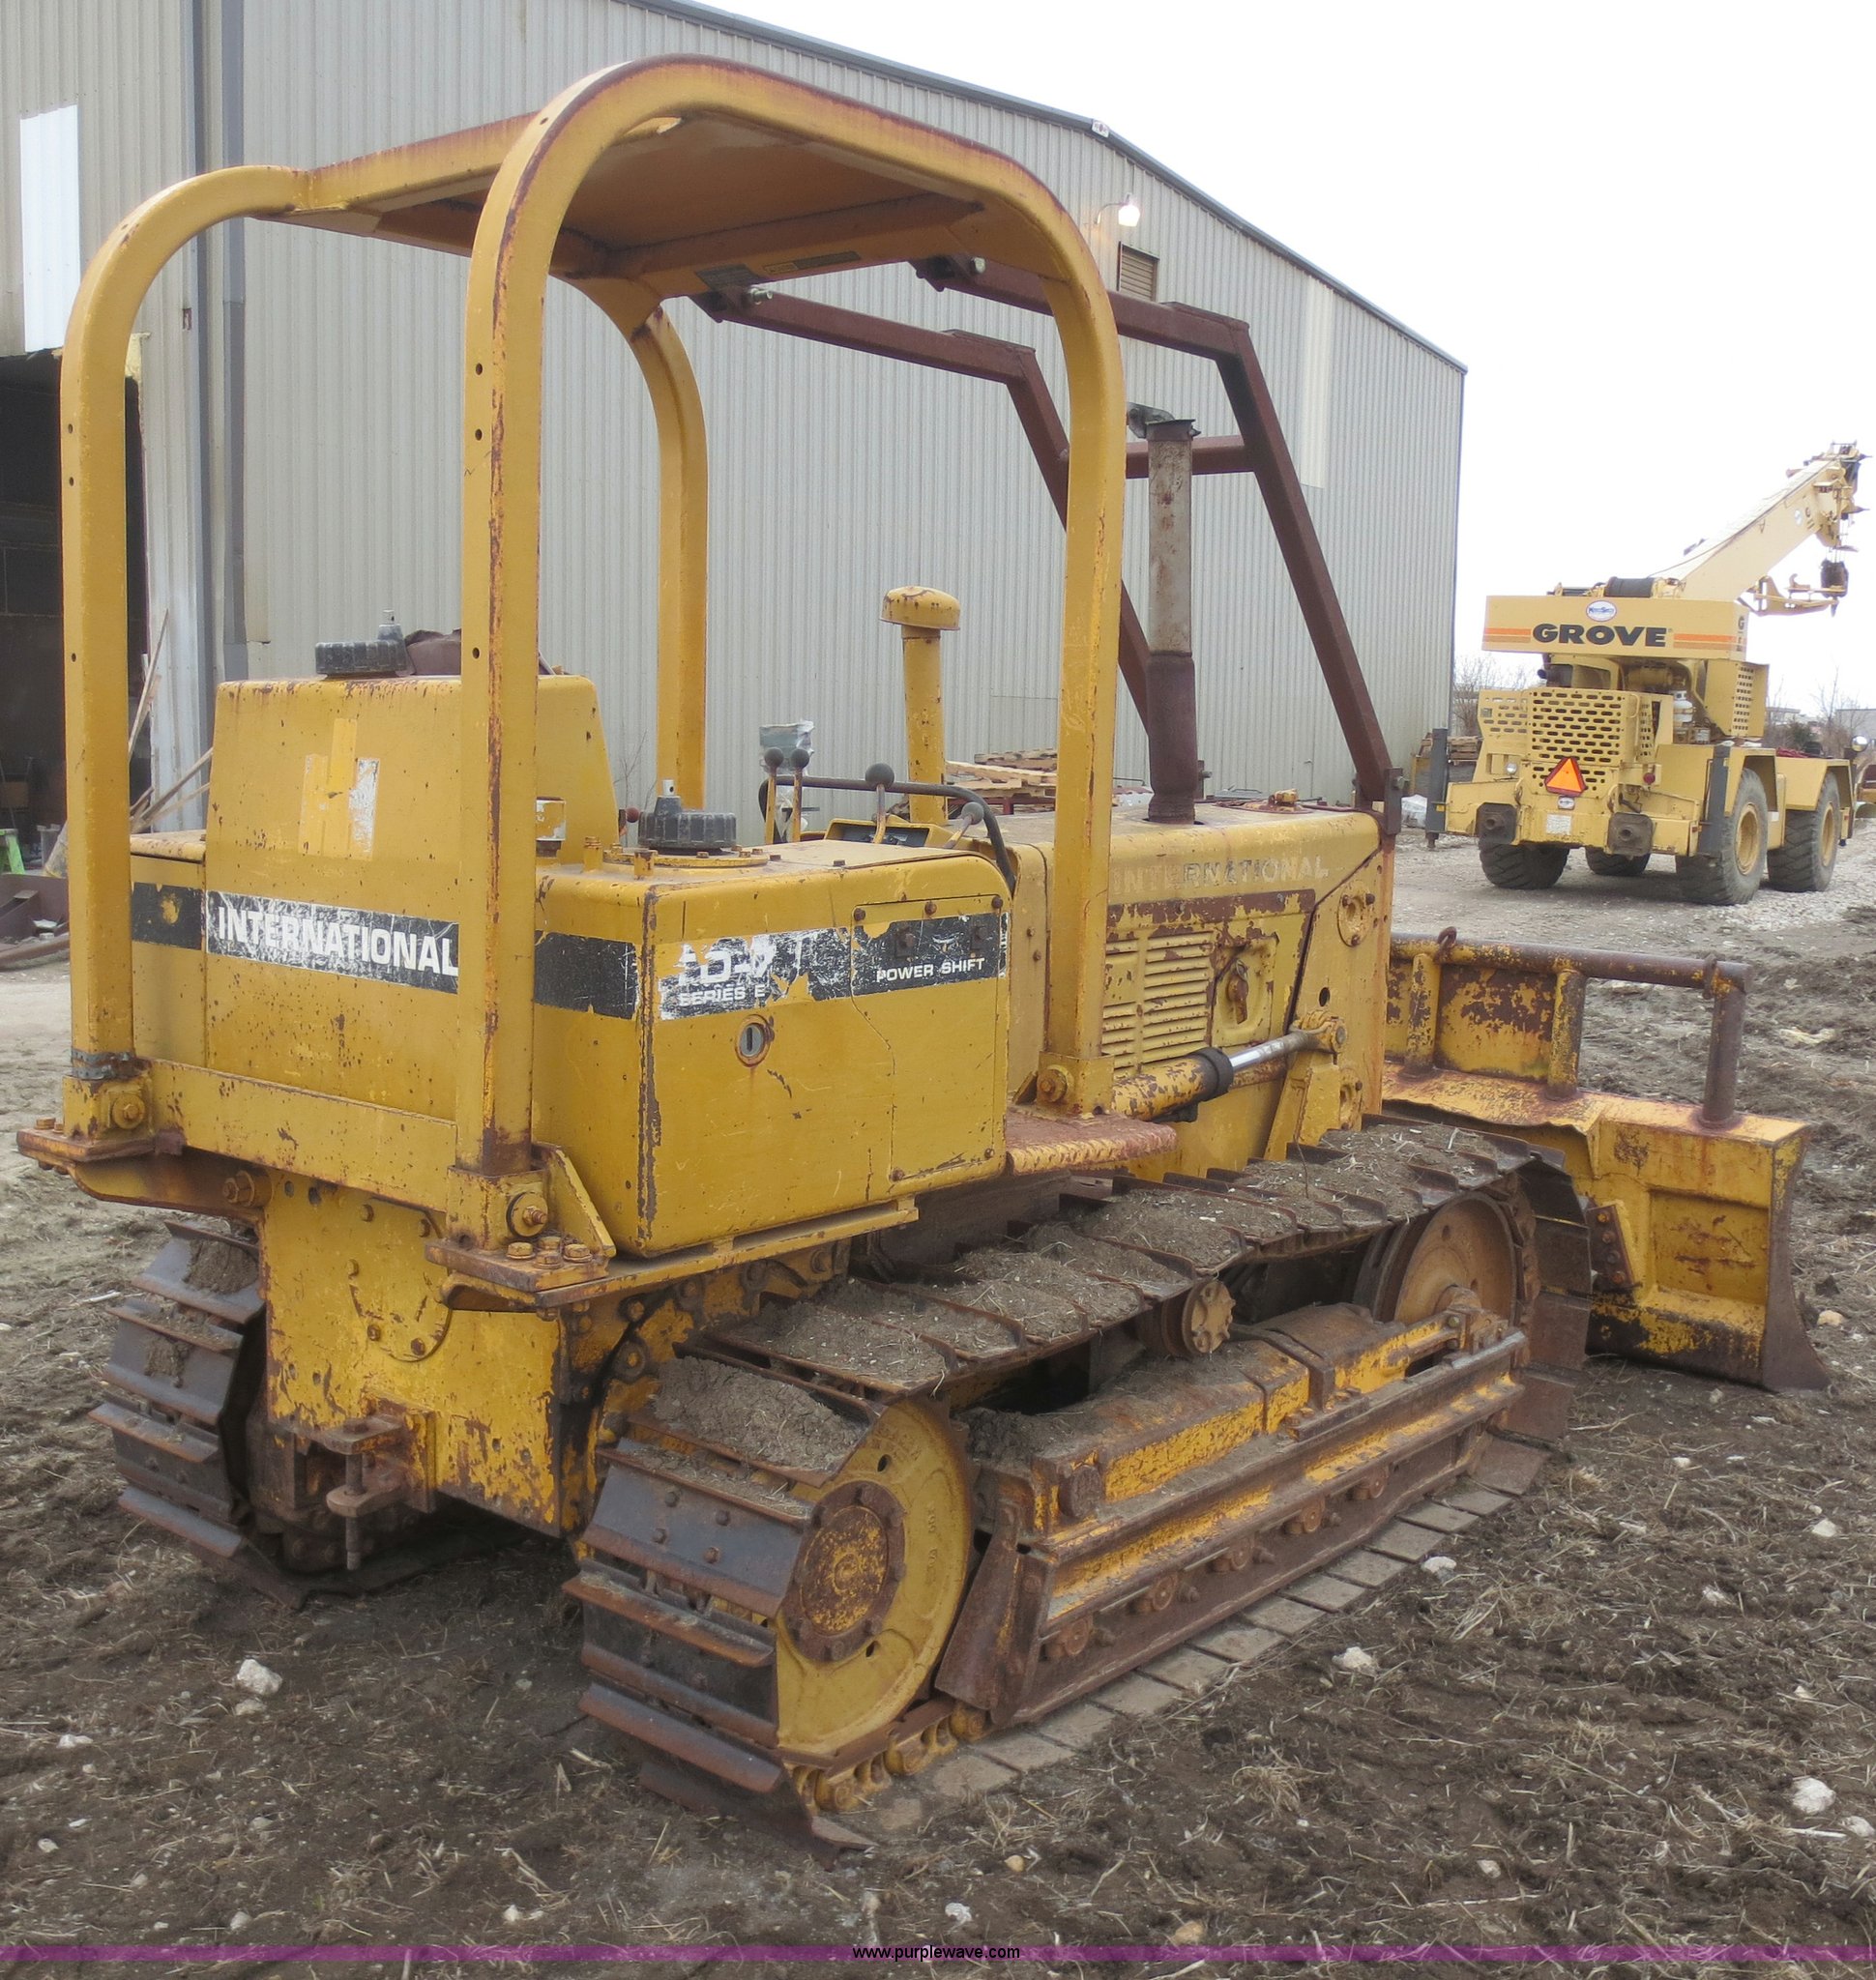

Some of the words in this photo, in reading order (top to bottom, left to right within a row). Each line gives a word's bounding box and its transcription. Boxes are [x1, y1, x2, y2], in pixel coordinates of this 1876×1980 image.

[1532, 623, 1667, 648] GROVE
[1112, 855, 1329, 895] INTERNATIONAL
[218, 906, 459, 977] INTERNATIONAL
[876, 964, 934, 982] POWER
[941, 957, 985, 975] SHIFT
[678, 983, 747, 1006] SERIES
[754, 984, 766, 999] E
